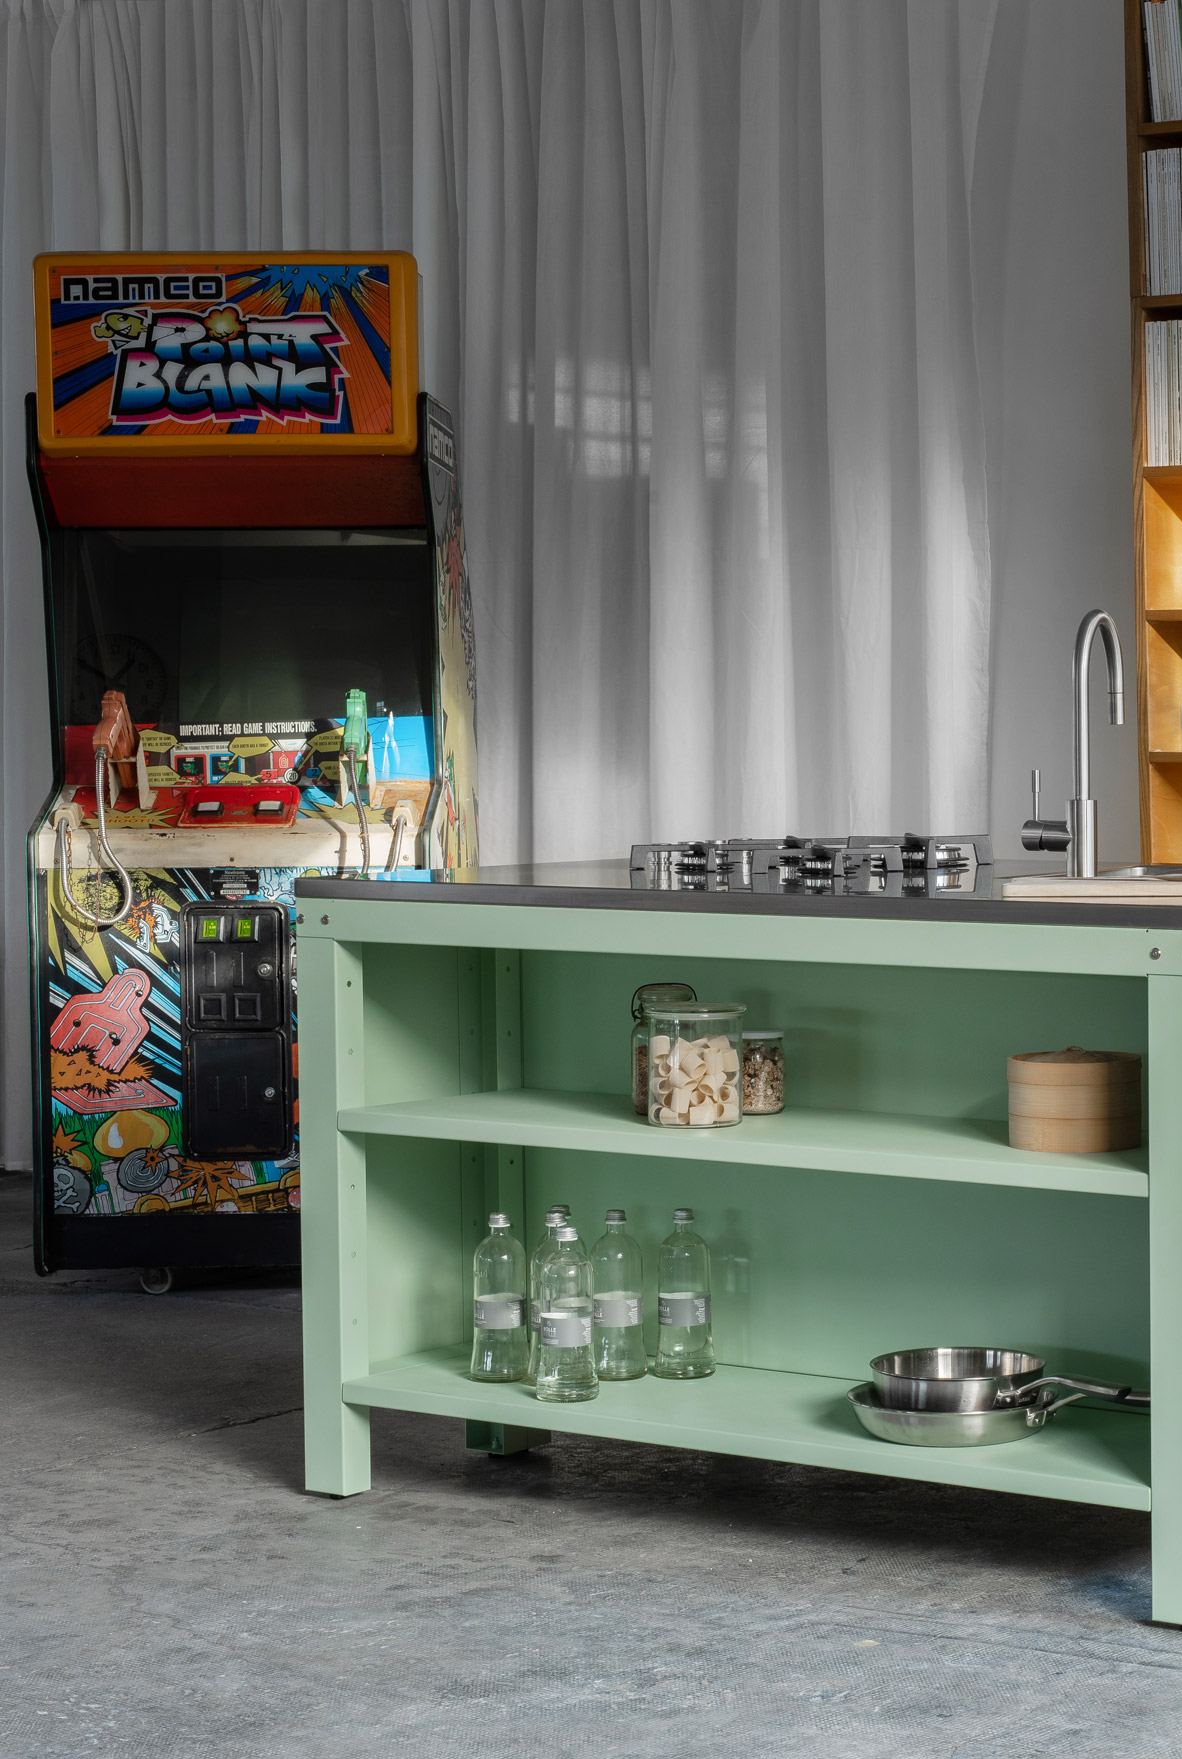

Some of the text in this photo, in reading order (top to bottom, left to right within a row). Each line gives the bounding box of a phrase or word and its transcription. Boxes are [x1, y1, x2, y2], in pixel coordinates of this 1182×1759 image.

[63, 275, 223, 301] namco
[116, 350, 336, 412] BLANK
[429, 423, 453, 468] namco
[179, 721, 317, 737] IMPORTANT; READ GAME INSTRUCTIONS.
[288, 772, 297, 780] 20
